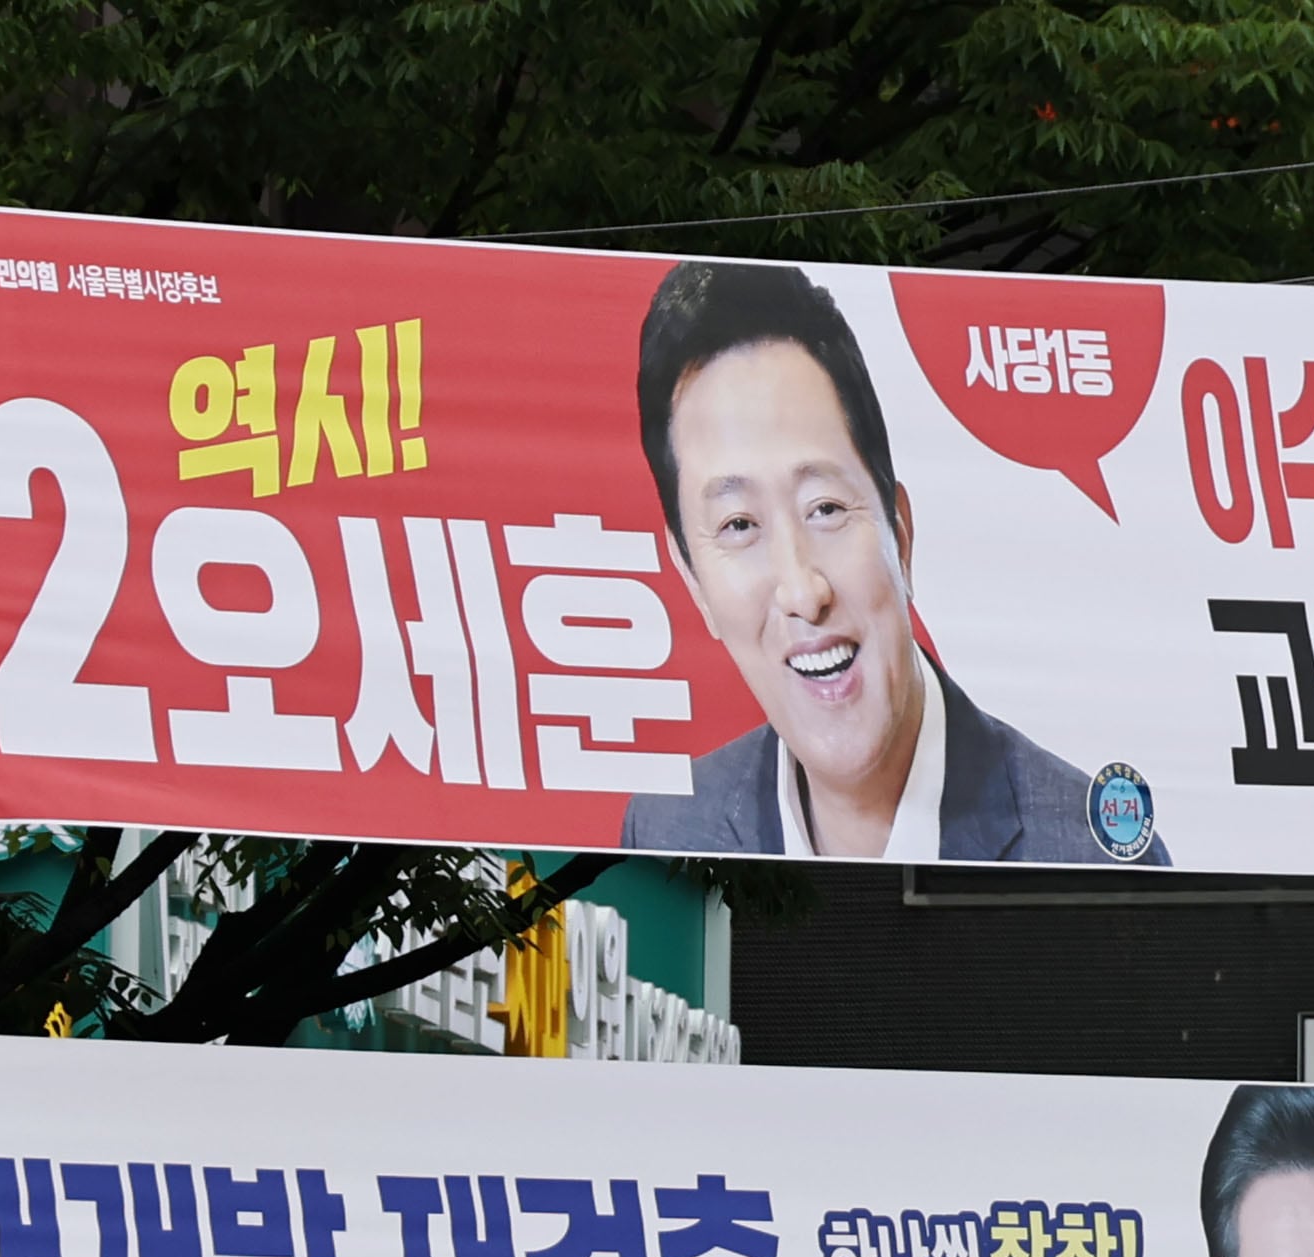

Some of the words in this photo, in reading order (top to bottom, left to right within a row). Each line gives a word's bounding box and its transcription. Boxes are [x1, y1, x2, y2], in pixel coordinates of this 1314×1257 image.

[67, 264, 221, 305] 서울특별시장후보
[965, 325, 1114, 397] 사당1동
[169, 318, 429, 498] 역시!
[151, 506, 695, 796] 오세훈
[1101, 798, 1139, 828] 선거
